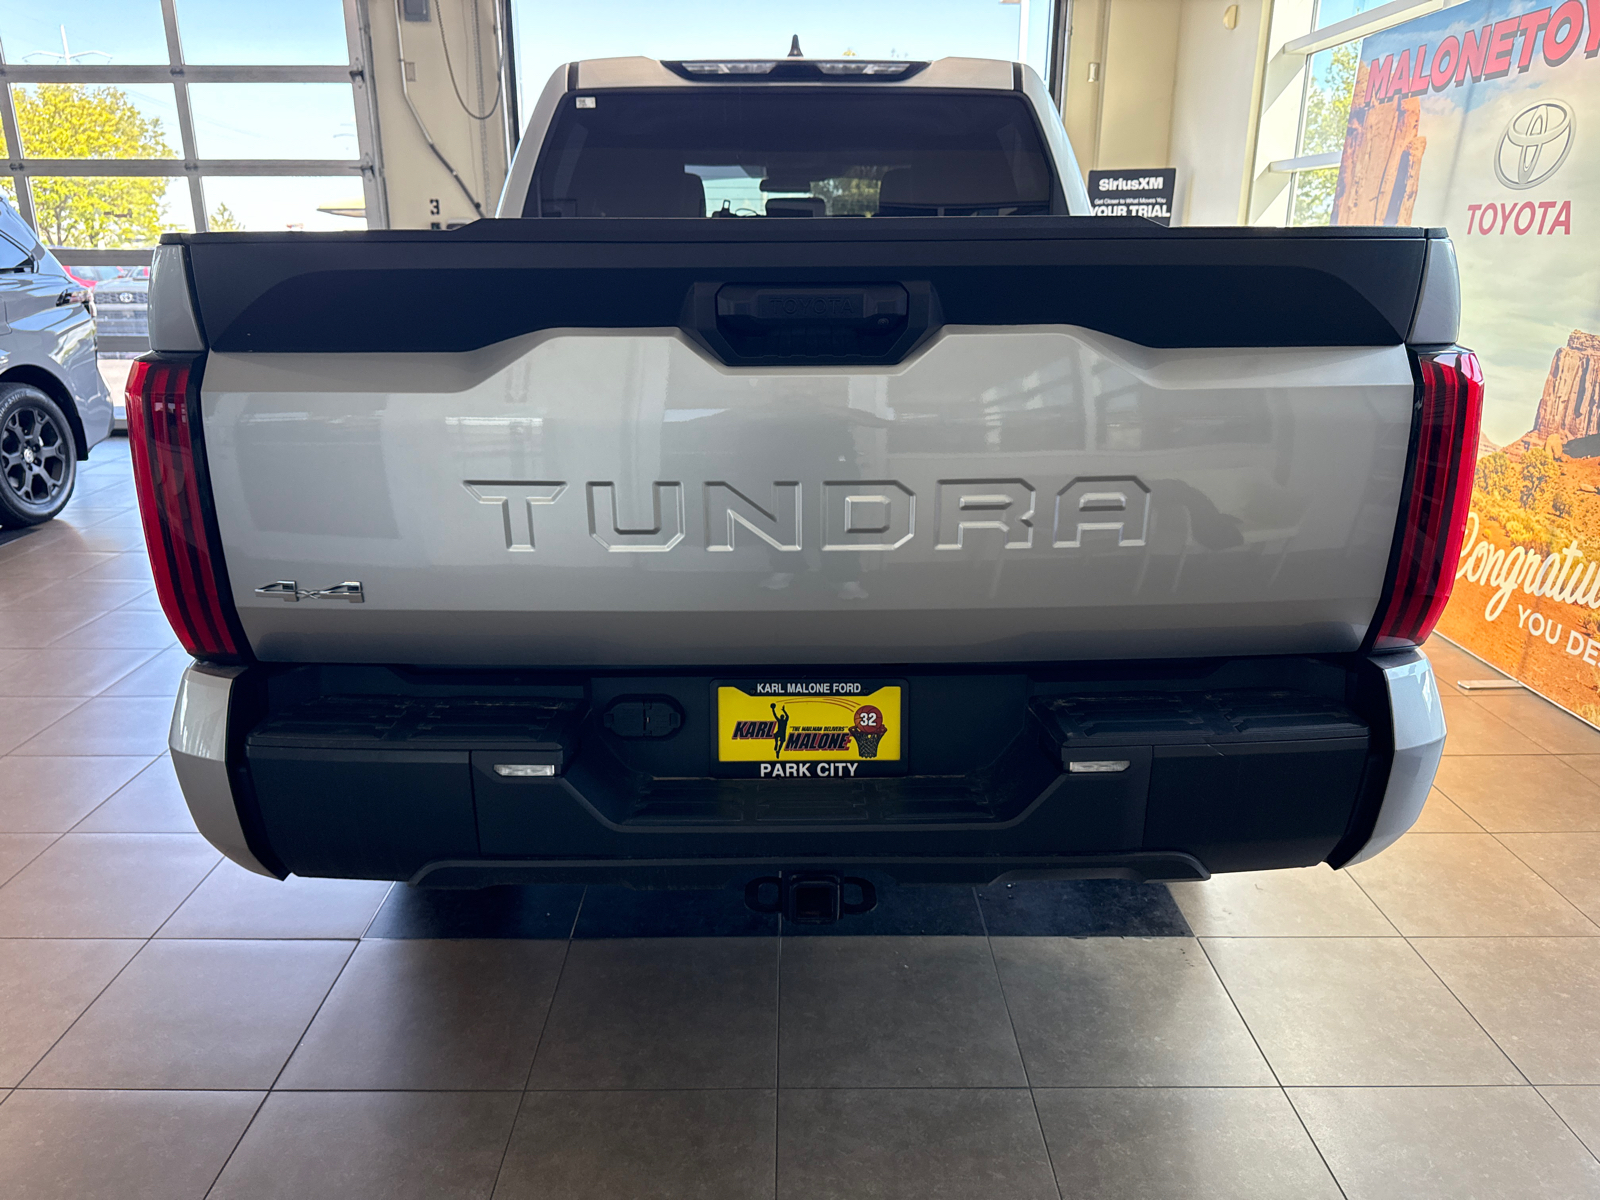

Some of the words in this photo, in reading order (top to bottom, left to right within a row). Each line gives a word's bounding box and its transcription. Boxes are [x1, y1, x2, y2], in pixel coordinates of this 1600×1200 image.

[1098, 177, 1164, 191] SiriusXM
[429, 199, 440, 215] 3
[1091, 205, 1127, 216] YOUR
[1129, 204, 1171, 218] TRIAL
[1466, 200, 1572, 236] TOYOTA
[769, 297, 855, 315] TOYOTA
[461, 475, 1151, 553] TUNDRA
[254, 580, 365, 603] 4x4
[1517, 604, 1563, 645] YOU
[1565, 630, 1600, 667] DE
[756, 683, 785, 694] KARL
[787, 683, 831, 694] MALONE
[833, 683, 862, 693] FORD
[859, 712, 877, 726] 32
[732, 721, 777, 740] KARL
[784, 732, 852, 751] MALONE
[760, 764, 811, 777] PARK
[816, 763, 859, 777] CITY
